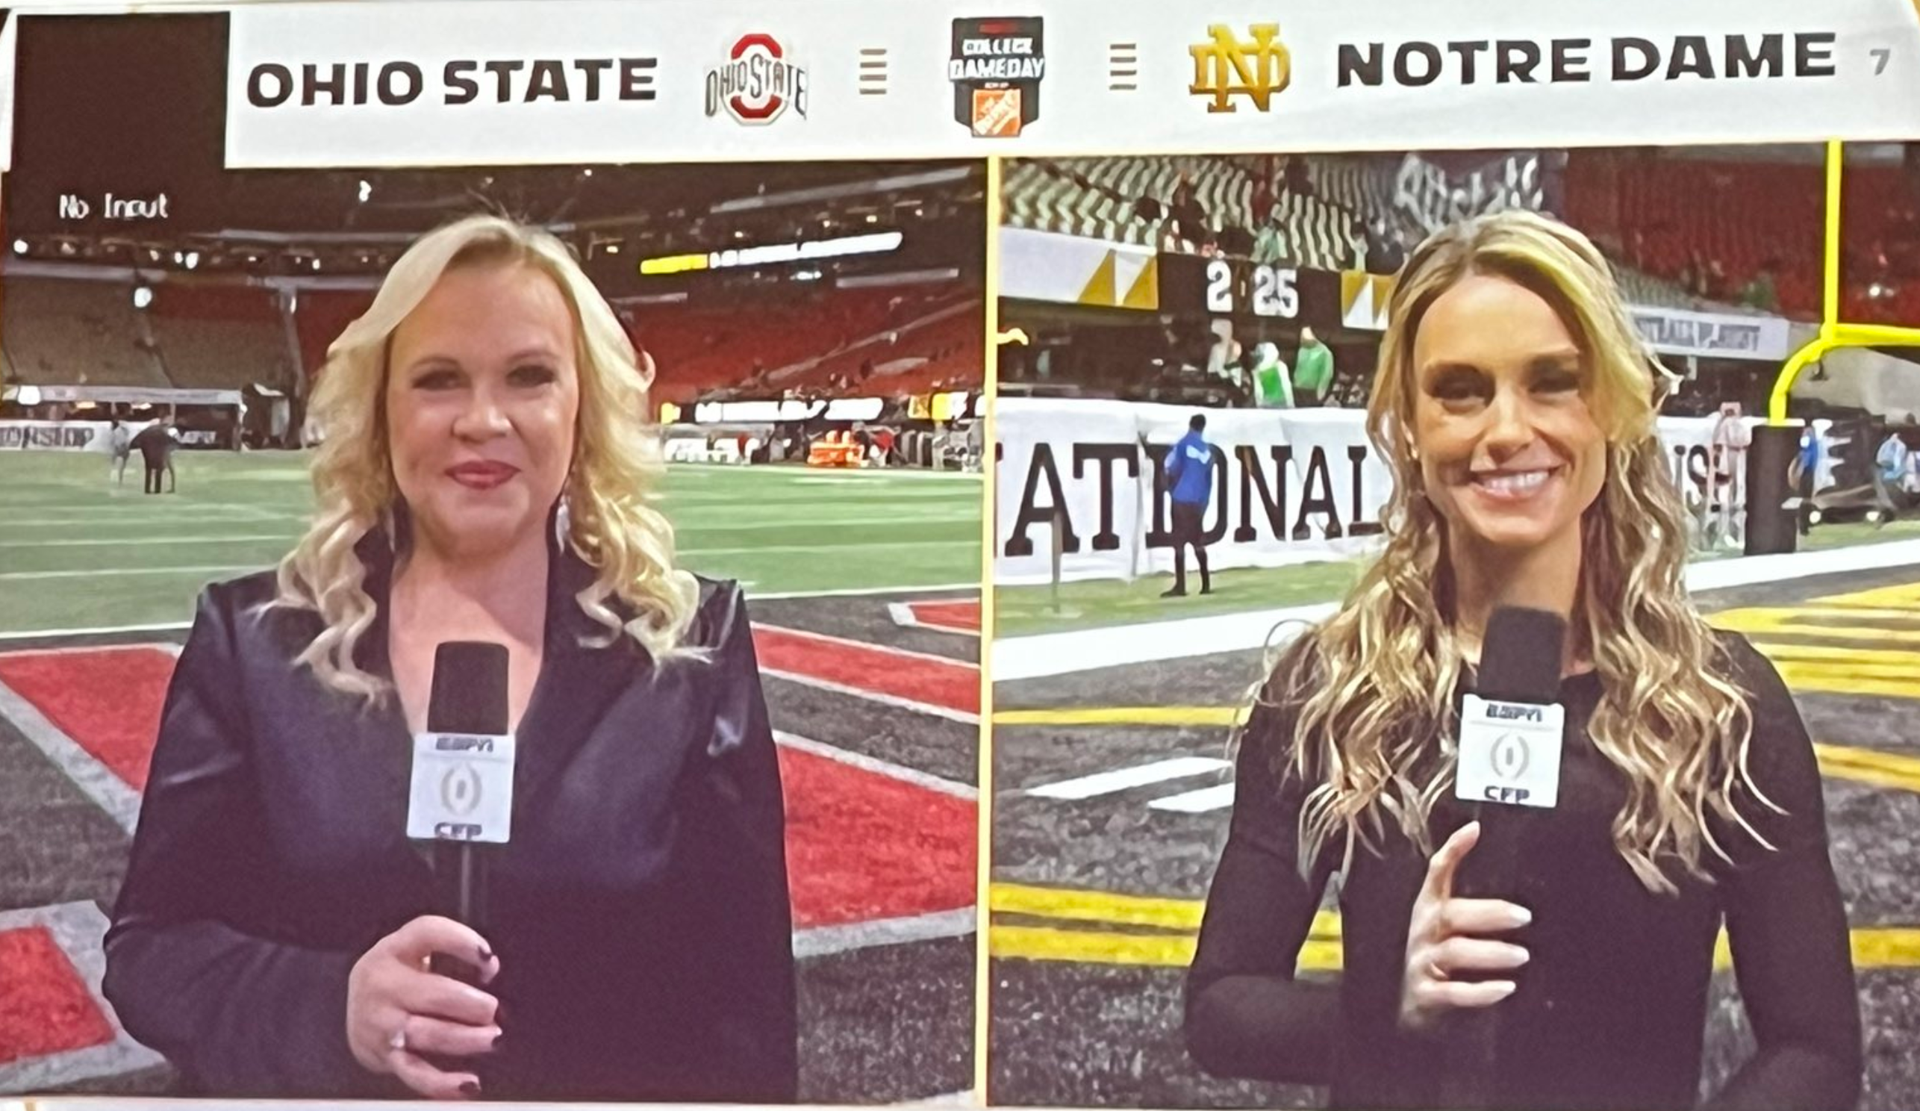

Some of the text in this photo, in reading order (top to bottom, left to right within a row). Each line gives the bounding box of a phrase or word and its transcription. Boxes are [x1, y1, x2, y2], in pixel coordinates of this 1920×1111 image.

[962, 37, 1033, 56] COLLEGE
[949, 57, 1044, 79] GAMEDAY
[1337, 32, 1836, 88] NOTRE DAME
[1870, 48, 1890, 75] 7
[247, 57, 658, 107] OHIO STATE
[705, 53, 807, 120] OHIO STATE
[59, 194, 90, 219] No
[994, 442, 1386, 558] ATIONAL
[1485, 703, 1543, 722] ESPN
[1484, 785, 1530, 804] CFP
